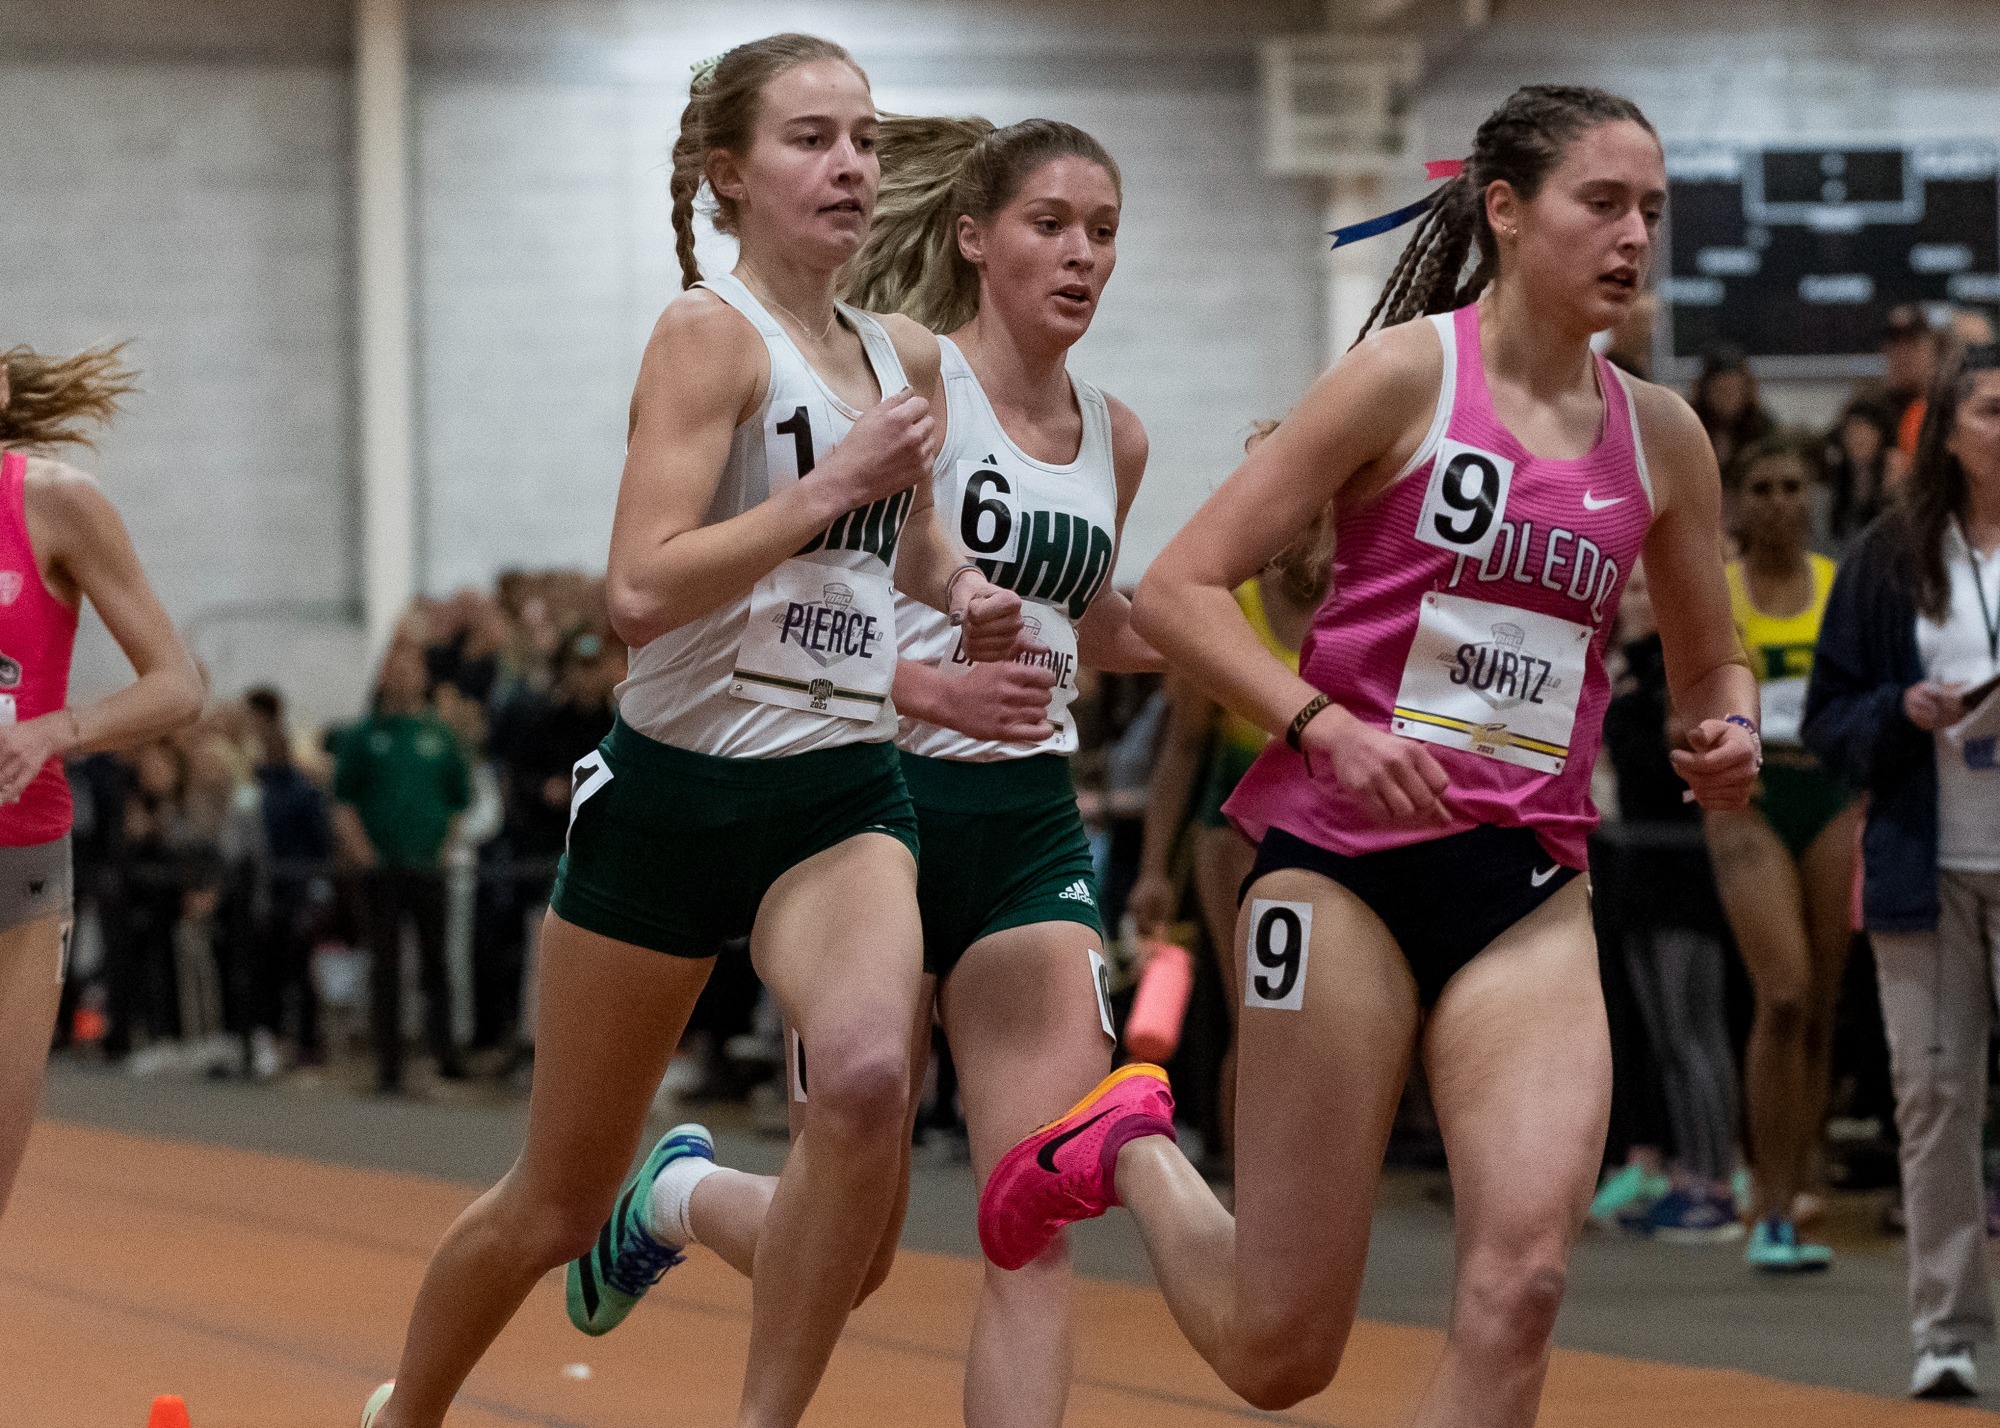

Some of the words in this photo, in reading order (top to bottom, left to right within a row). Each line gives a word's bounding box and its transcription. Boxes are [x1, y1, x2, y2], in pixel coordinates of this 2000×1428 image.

[777, 406, 815, 481] 1
[960, 469, 1012, 554] 6
[1434, 452, 1500, 545] 9
[780, 602, 877, 659] PIERCE
[810, 700, 828, 710] 2023
[1450, 643, 1552, 704] SURTZ
[1252, 905, 1303, 1002] 9
